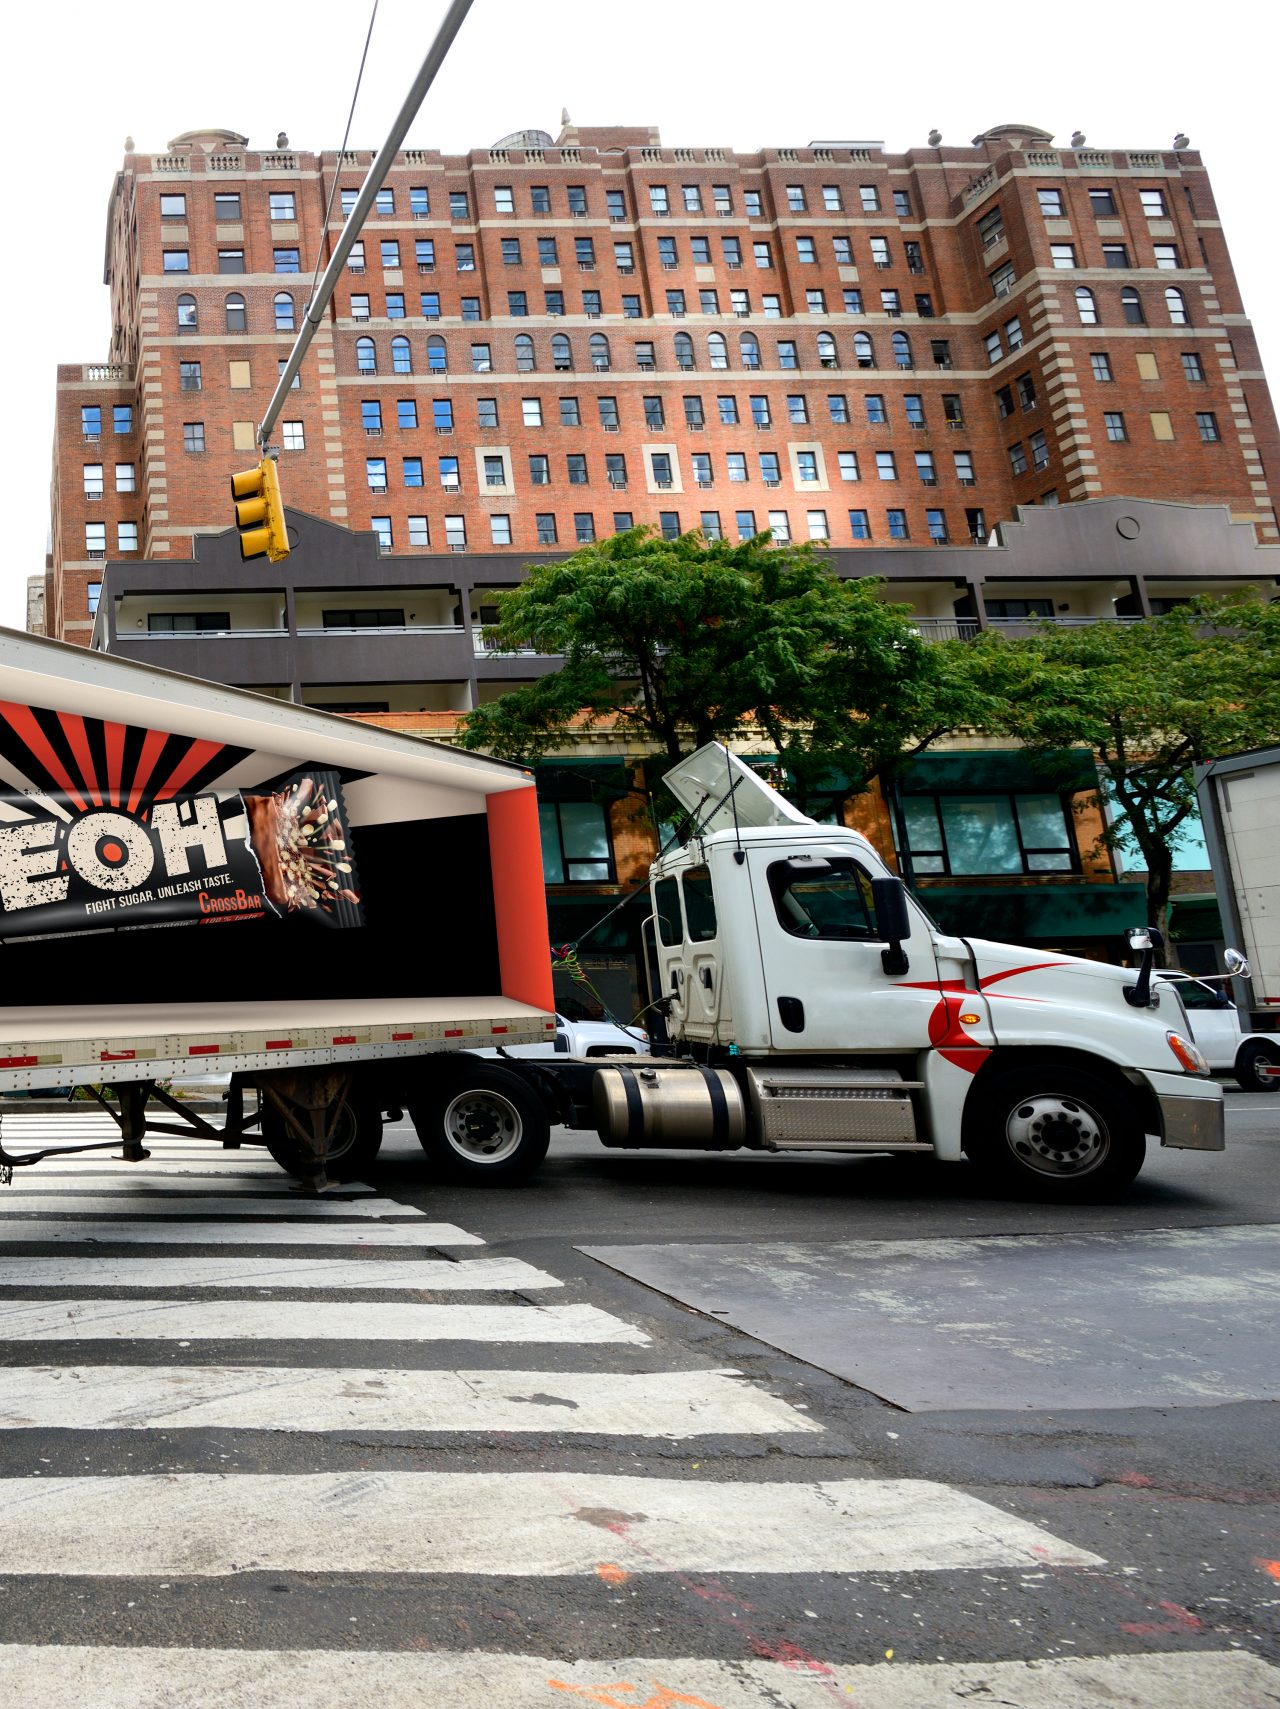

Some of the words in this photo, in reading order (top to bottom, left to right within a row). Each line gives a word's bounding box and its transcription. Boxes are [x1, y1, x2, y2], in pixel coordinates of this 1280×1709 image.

[85, 898, 116, 915] FIGHT
[119, 890, 156, 907] SUGAR.
[158, 880, 202, 899] UNLEASH
[202, 873, 234, 889] TASTE.
